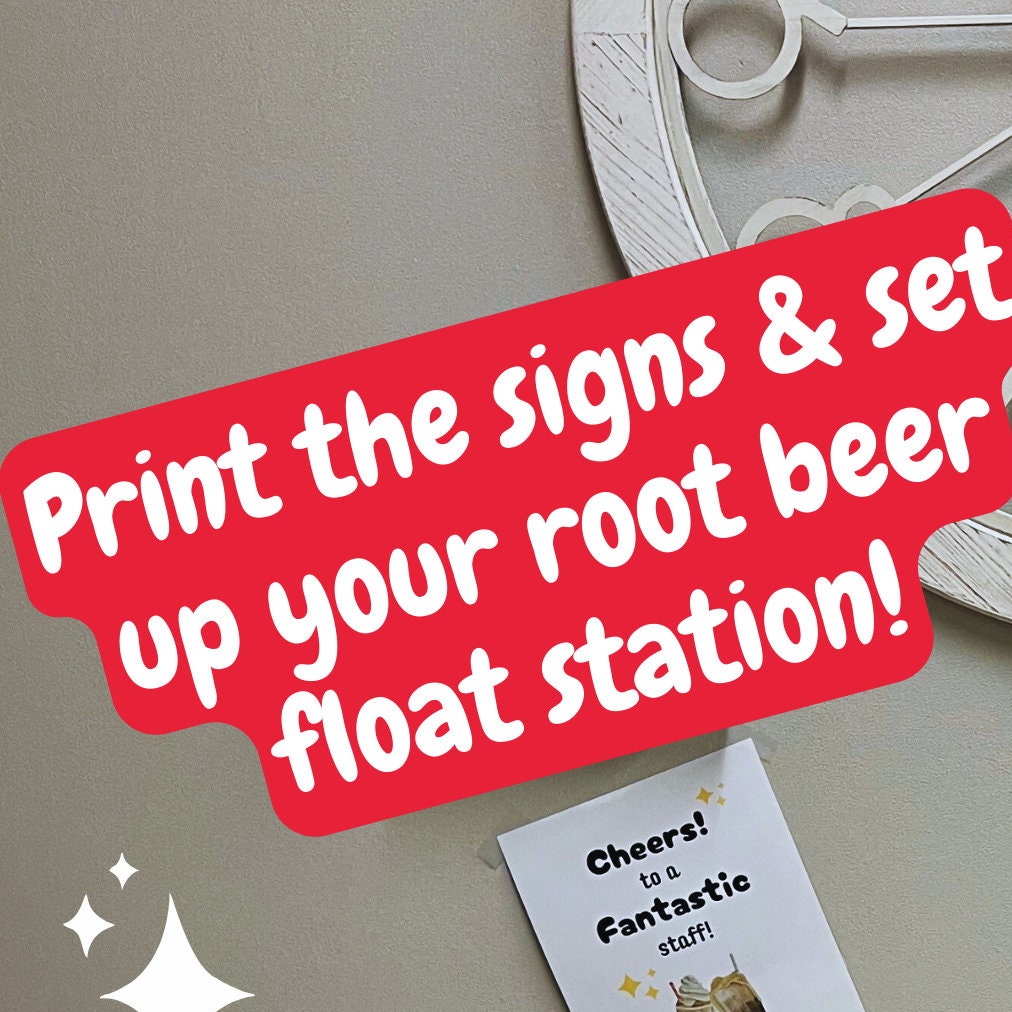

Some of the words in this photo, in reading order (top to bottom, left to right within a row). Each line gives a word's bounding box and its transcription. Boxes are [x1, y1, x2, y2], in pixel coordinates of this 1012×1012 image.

[587, 811, 709, 875] Cheers!
[639, 871, 661, 889] to
[665, 865, 681, 880] a
[597, 872, 751, 944] Fantastic
[658, 920, 715, 957] staff!
